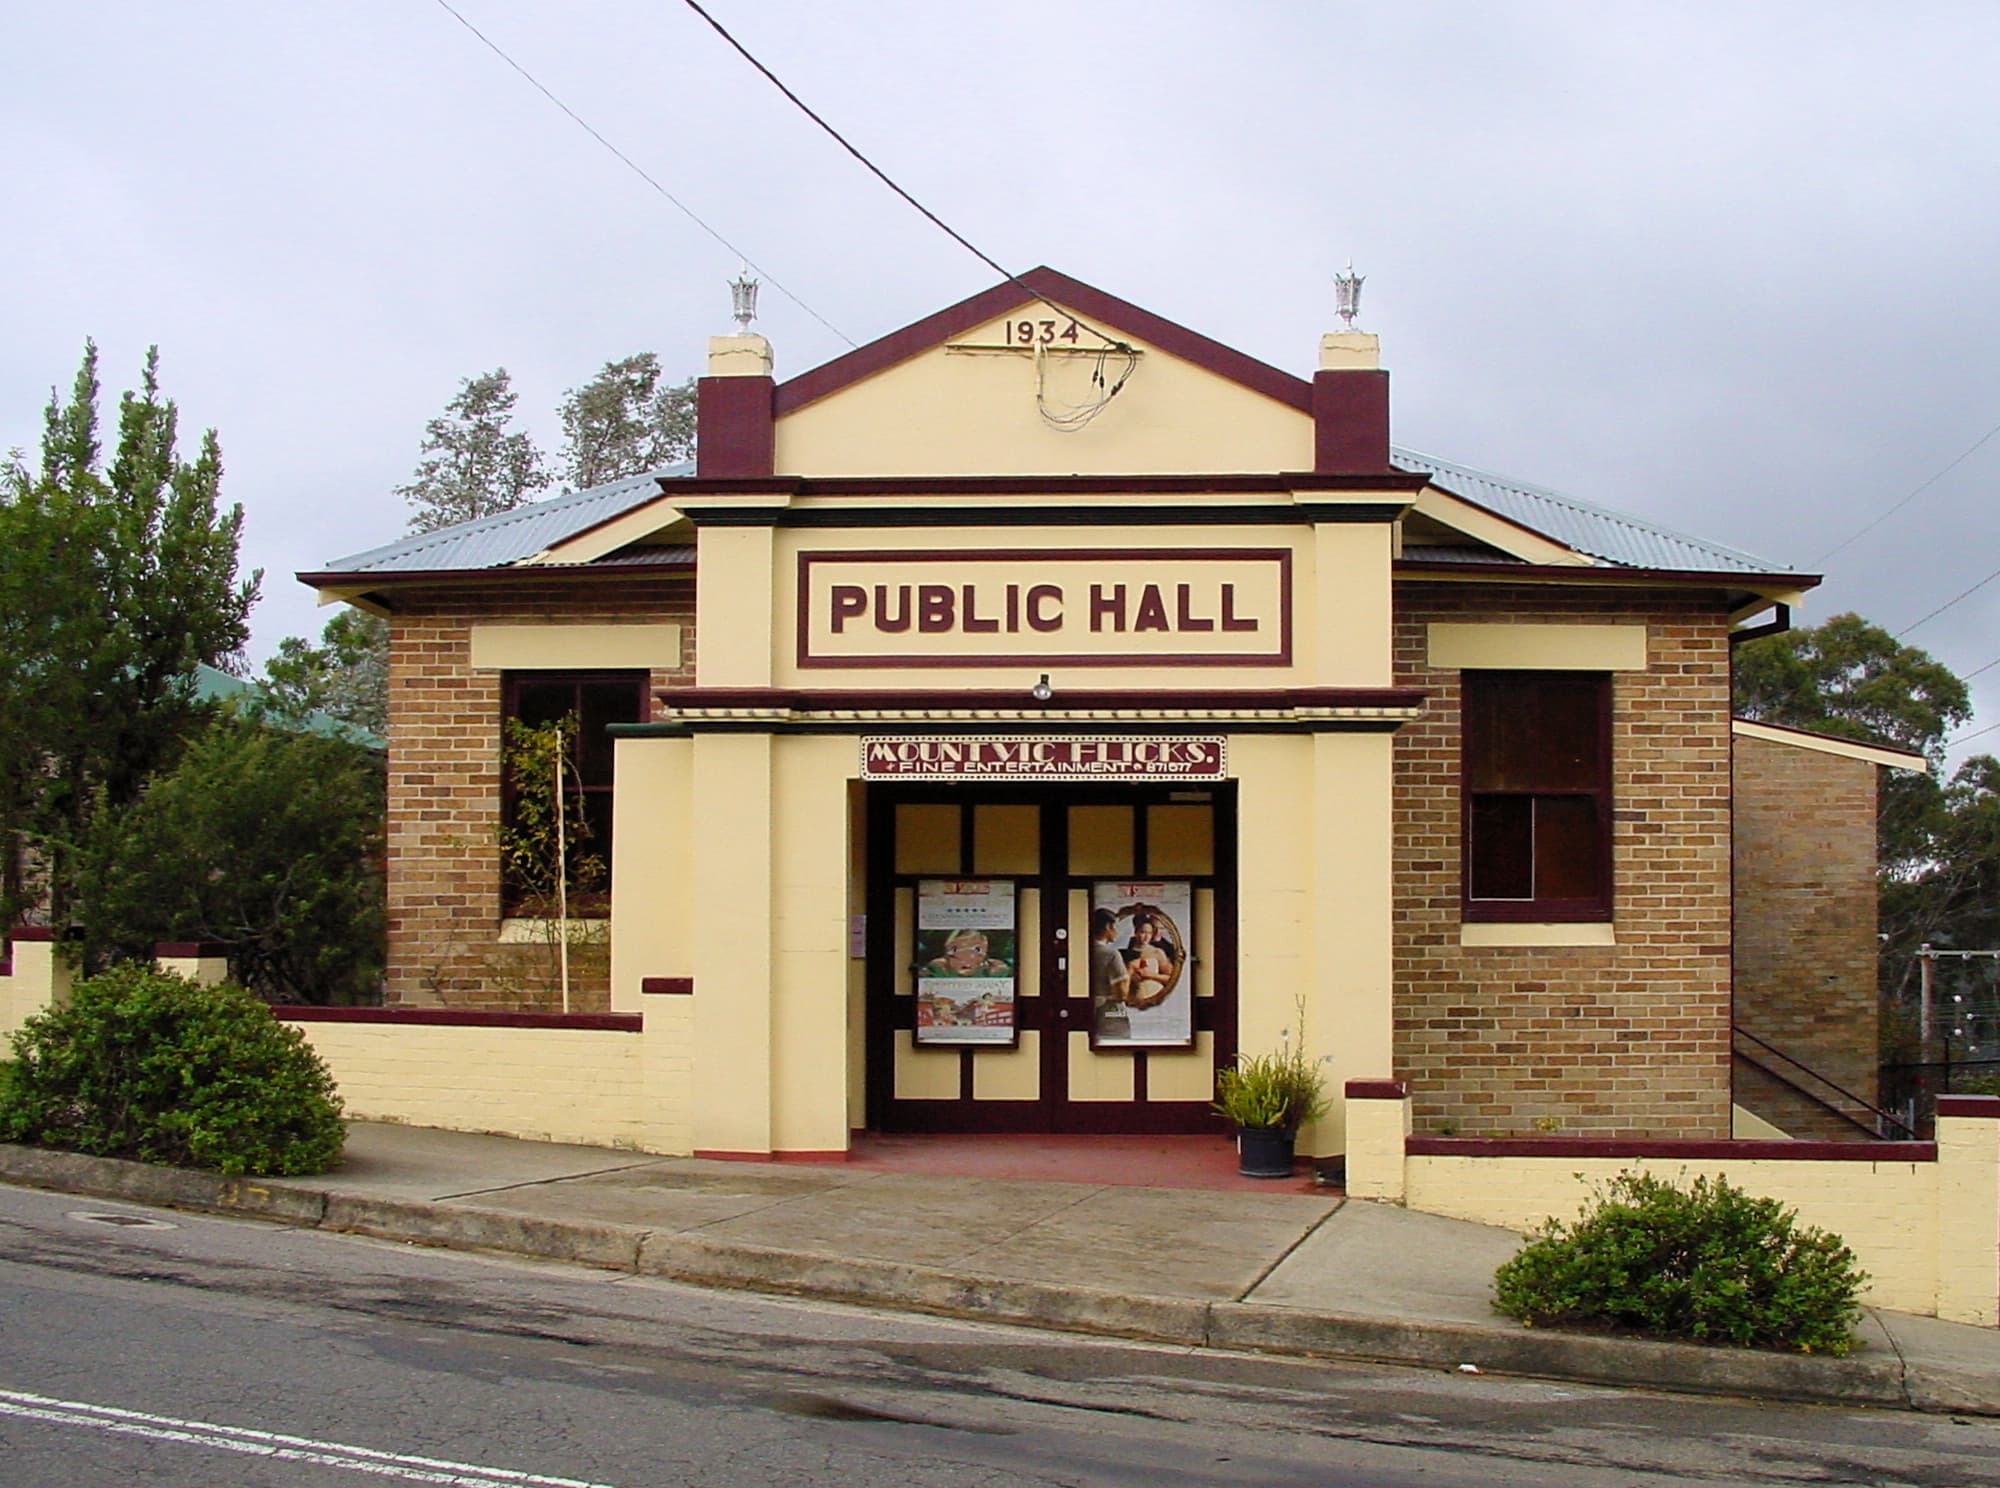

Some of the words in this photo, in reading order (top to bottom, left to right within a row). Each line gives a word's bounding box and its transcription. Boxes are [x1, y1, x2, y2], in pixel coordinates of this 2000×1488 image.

[1006, 320, 1079, 345] 1934
[831, 584, 1064, 634] PUBLIC
[1089, 583, 1259, 633] HALL
[869, 742, 988, 762] MOUNT
[991, 742, 1056, 762] VIC
[1070, 742, 1214, 763] FLICKS.
[899, 761, 956, 773] FINE
[963, 761, 1132, 773] ENTERTAINMENT
